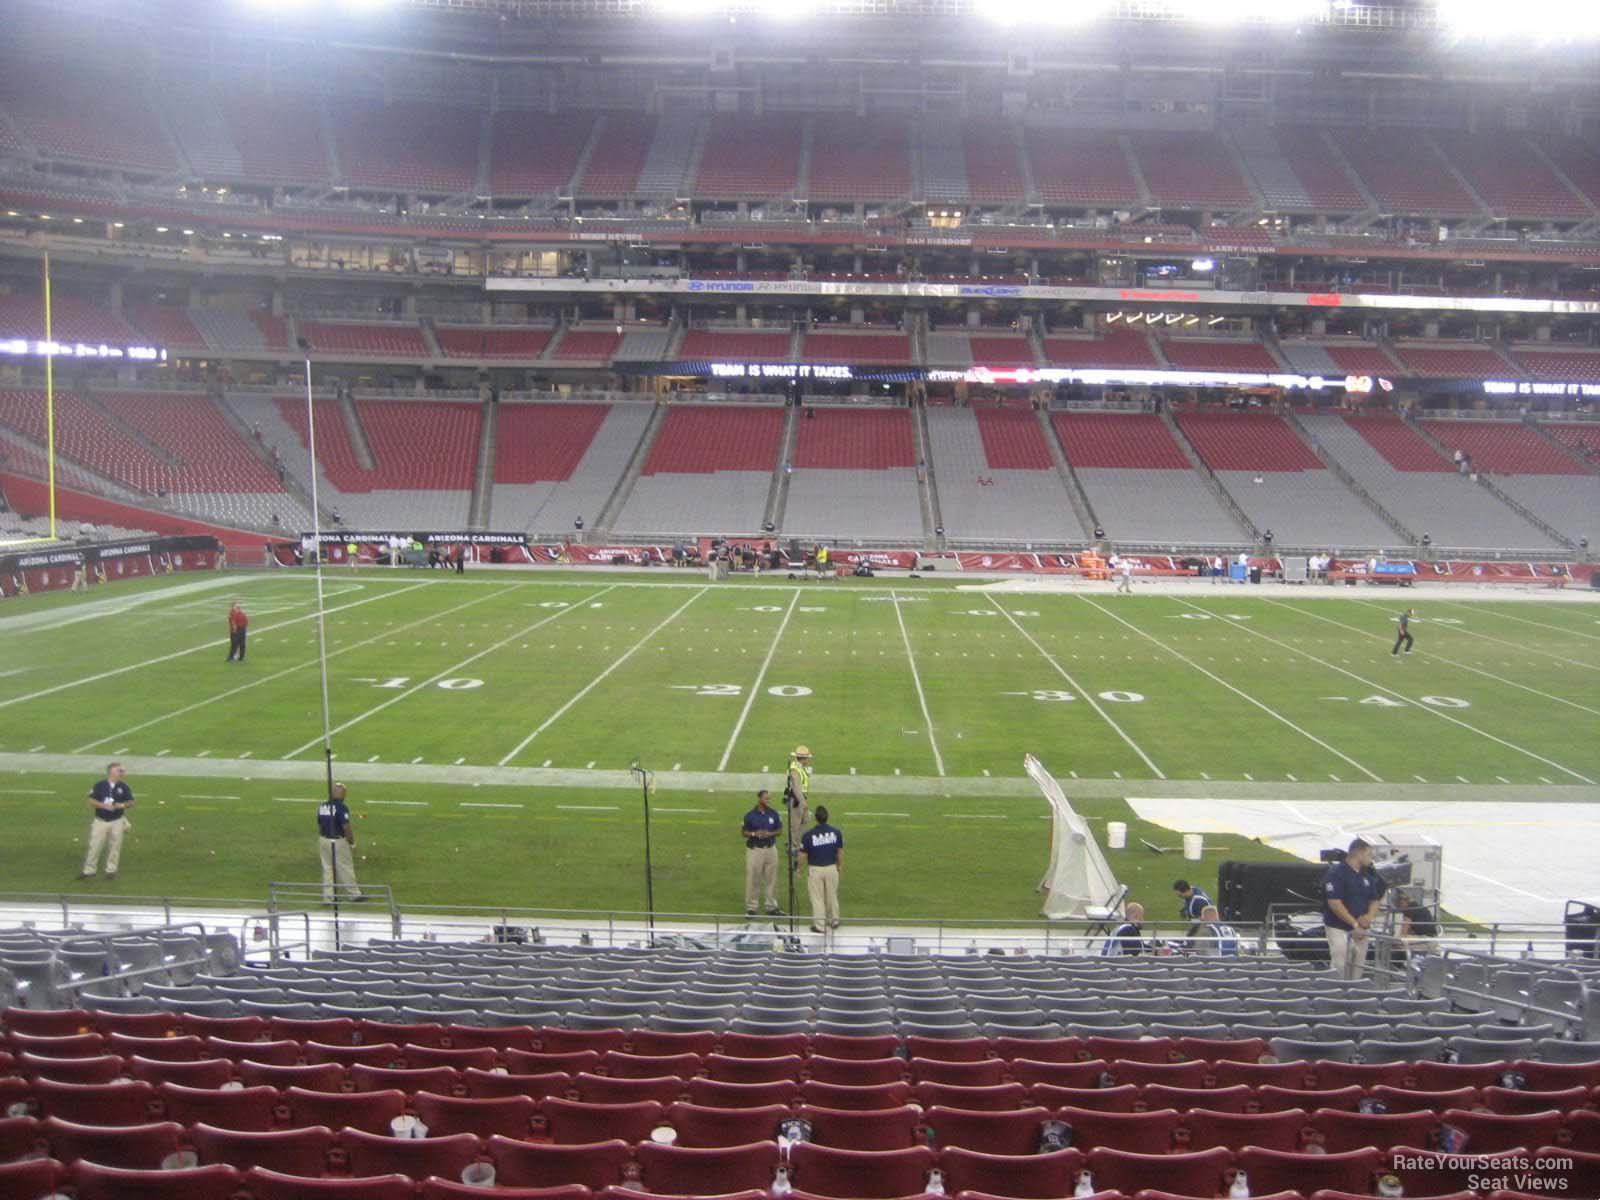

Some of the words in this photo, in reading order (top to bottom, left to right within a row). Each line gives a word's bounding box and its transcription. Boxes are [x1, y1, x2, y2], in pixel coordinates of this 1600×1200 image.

[1209, 245, 1238, 253] LARRY
[1241, 246, 1276, 254] WILSON
[706, 281, 753, 291] HYUNDAI
[748, 364, 761, 377] IS
[762, 365, 798, 378] WHAT
[799, 365, 812, 378] IT
[472, 535, 524, 543] CARDINALS
[19, 556, 49, 566] ARIZONA
